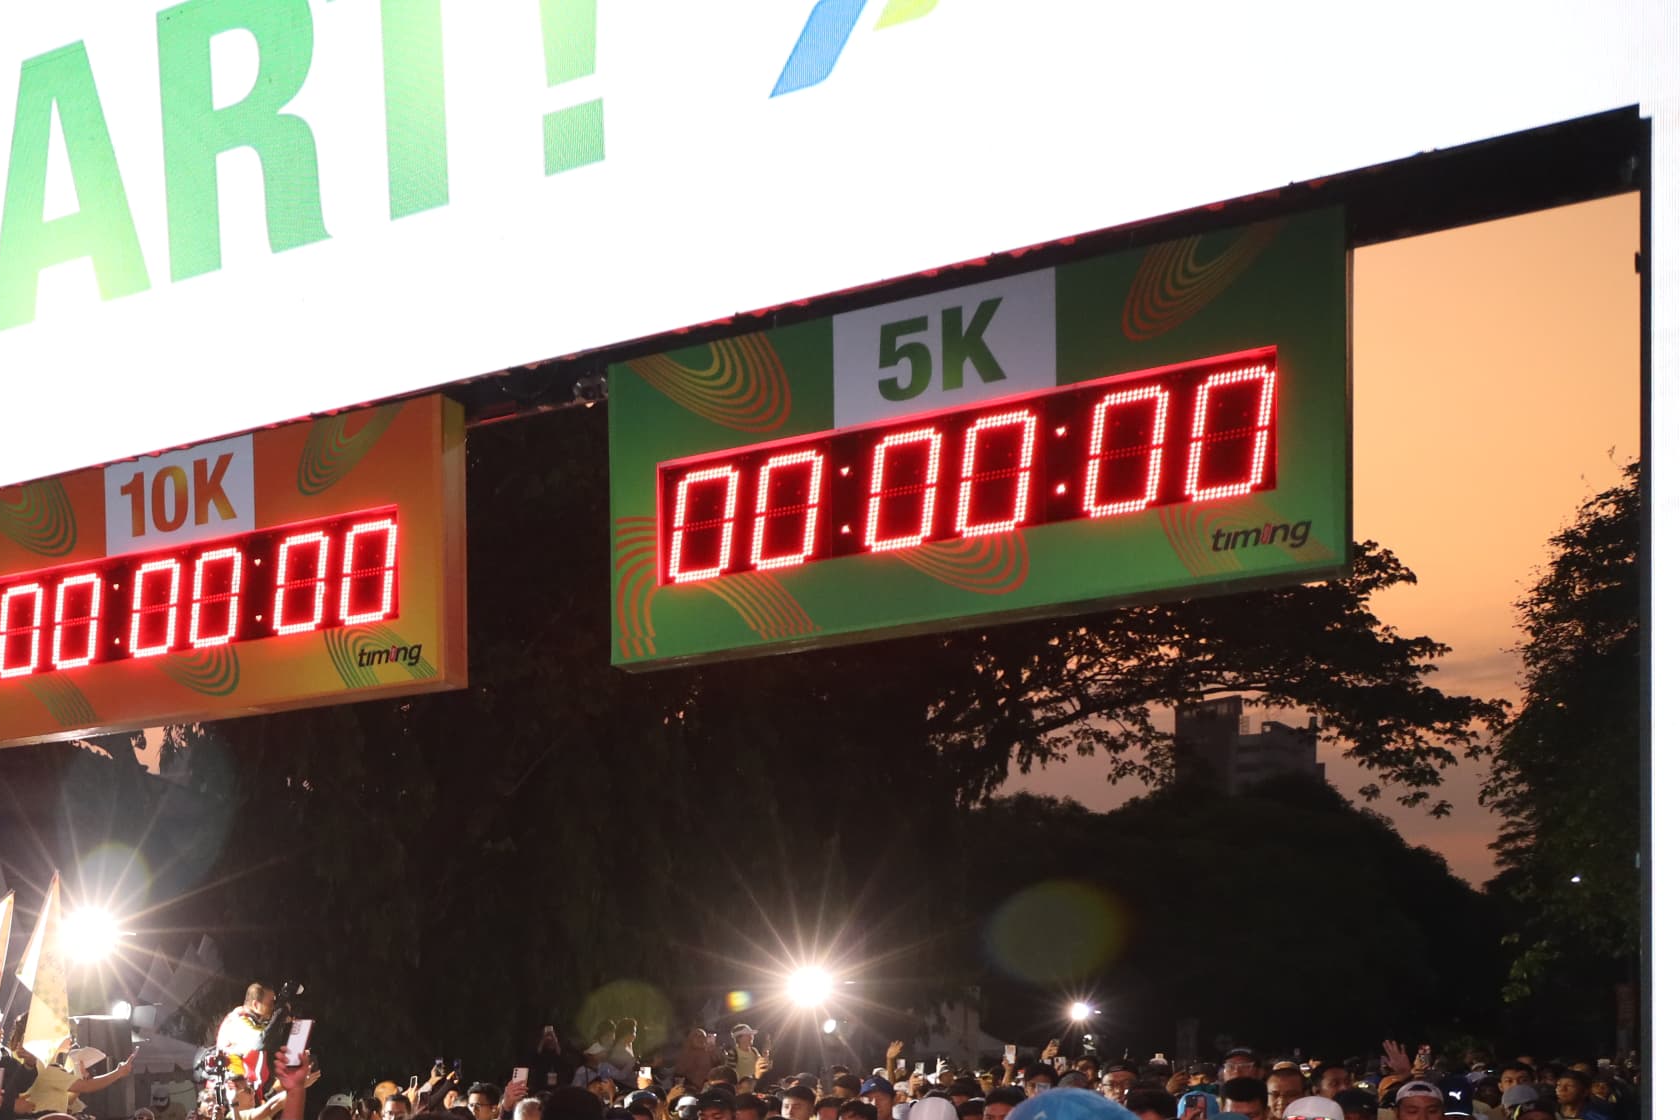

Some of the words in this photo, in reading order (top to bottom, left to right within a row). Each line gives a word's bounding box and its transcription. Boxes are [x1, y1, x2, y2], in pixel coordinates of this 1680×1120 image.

[877, 297, 1008, 402] 5K
[120, 452, 238, 538] 10K
[669, 364, 1276, 585] 00:00:00
[1210, 519, 1312, 556] timing
[357, 643, 422, 668] timing
